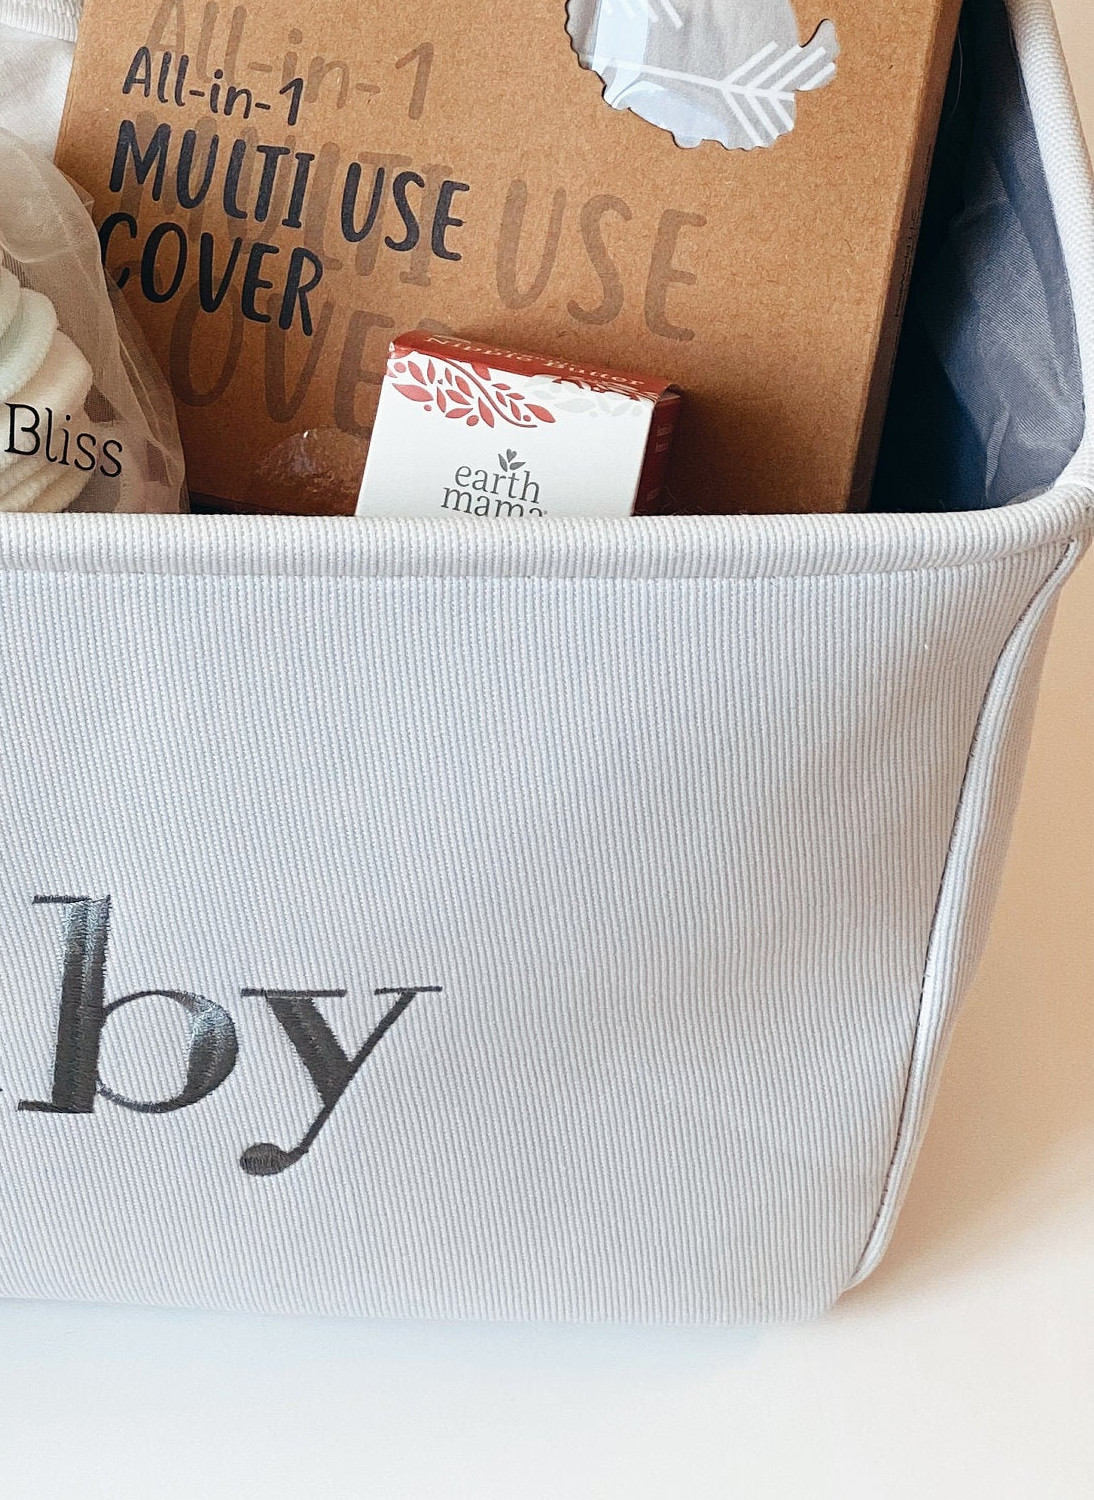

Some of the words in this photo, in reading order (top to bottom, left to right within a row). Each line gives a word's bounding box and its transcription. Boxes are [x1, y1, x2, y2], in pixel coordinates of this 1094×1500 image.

[121, 45, 305, 126] All-in-1
[109, 119, 314, 229] MULTI
[340, 161, 470, 262] USE
[97, 212, 323, 337] COVER
[496, 179, 707, 341] USE
[4, 402, 124, 477] Bliss
[455, 464, 541, 504] earth
